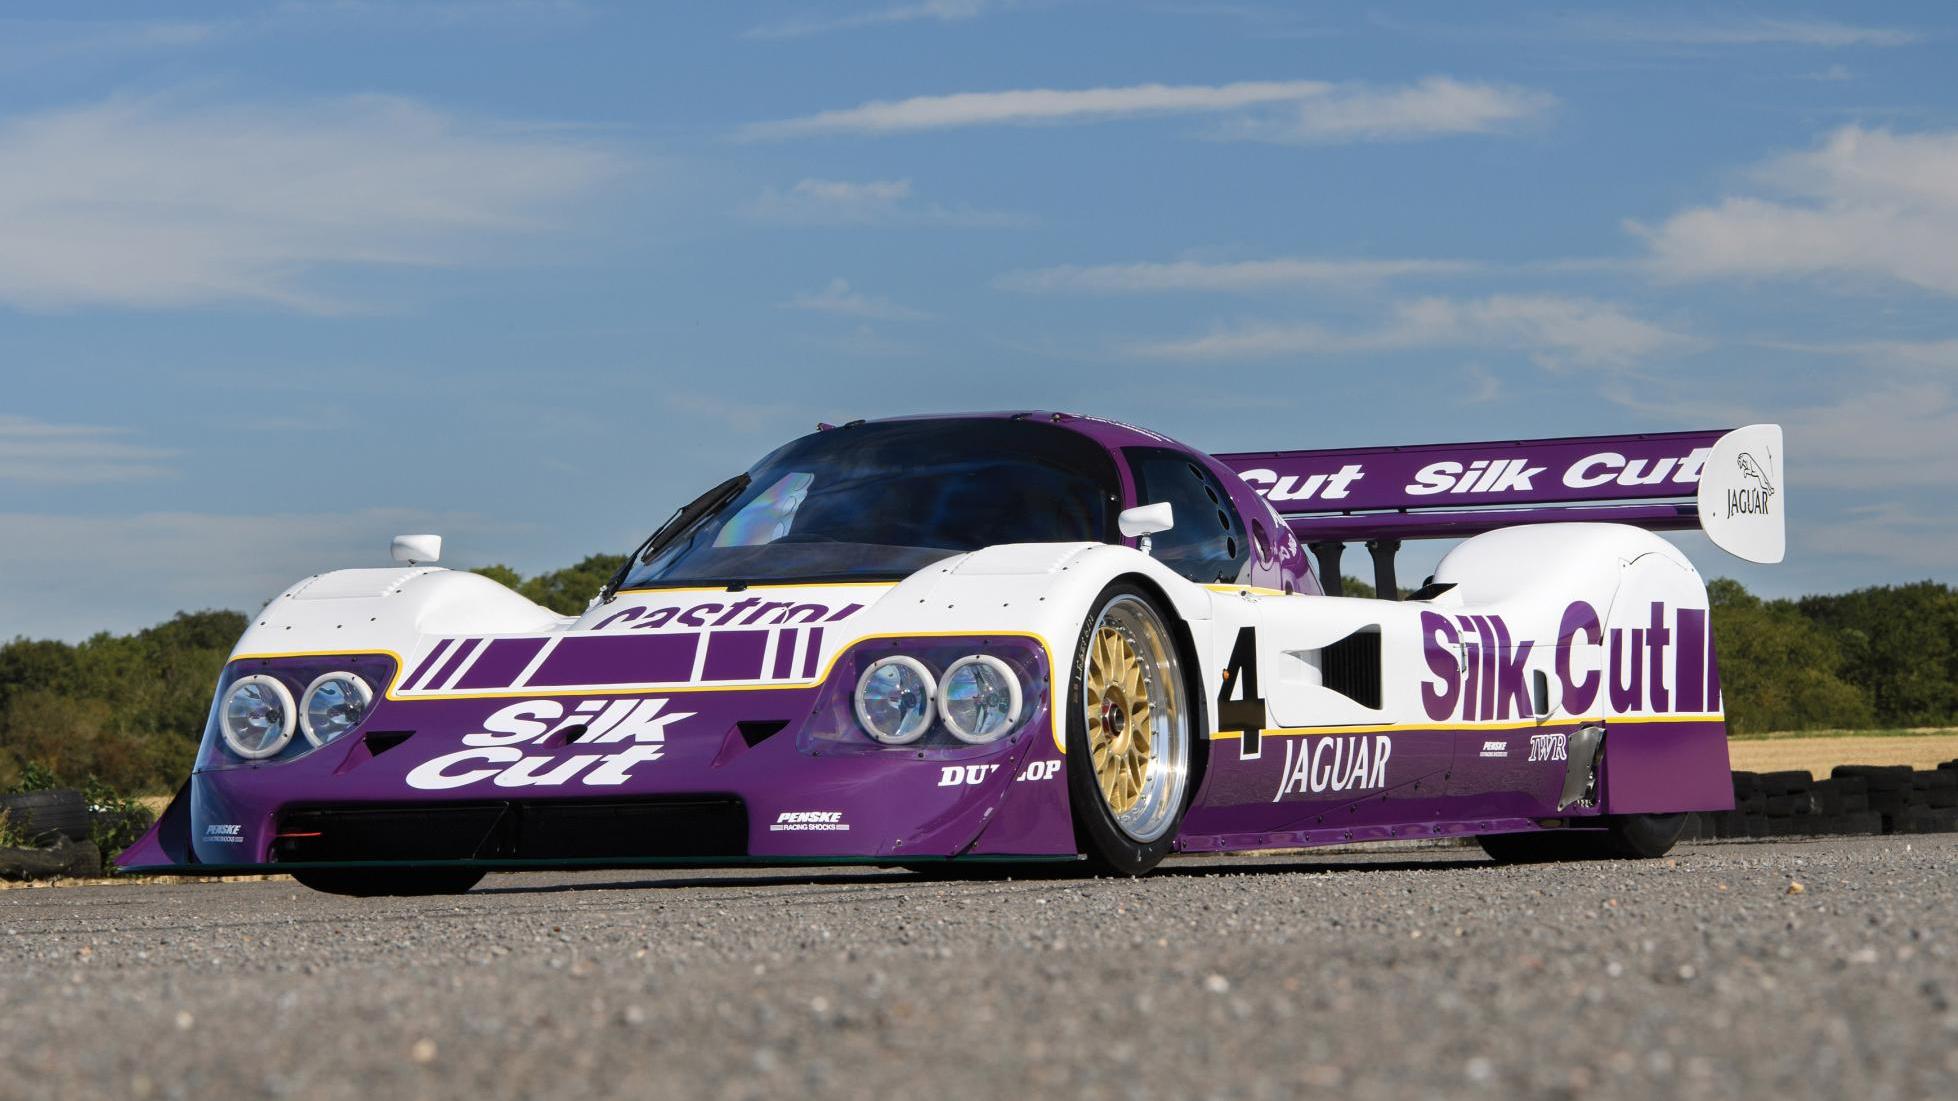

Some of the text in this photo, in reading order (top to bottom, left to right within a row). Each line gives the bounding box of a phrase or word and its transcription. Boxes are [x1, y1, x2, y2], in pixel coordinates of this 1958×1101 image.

[1404, 458, 1548, 496] Silk
[1562, 446, 1713, 489] Cut
[1727, 487, 1769, 519] JAGUAR
[1420, 600, 1670, 722] Silk Cut
[1217, 625, 1267, 760] 4
[461, 698, 698, 747] Silk
[405, 744, 665, 790] Cut
[1272, 735, 1392, 803] JAGUAR
[1527, 733, 1568, 762] TWR
[937, 759, 1062, 787] DUOP
[776, 811, 842, 823] PENSKE
[783, 823, 836, 831] RACING SHOCKS
